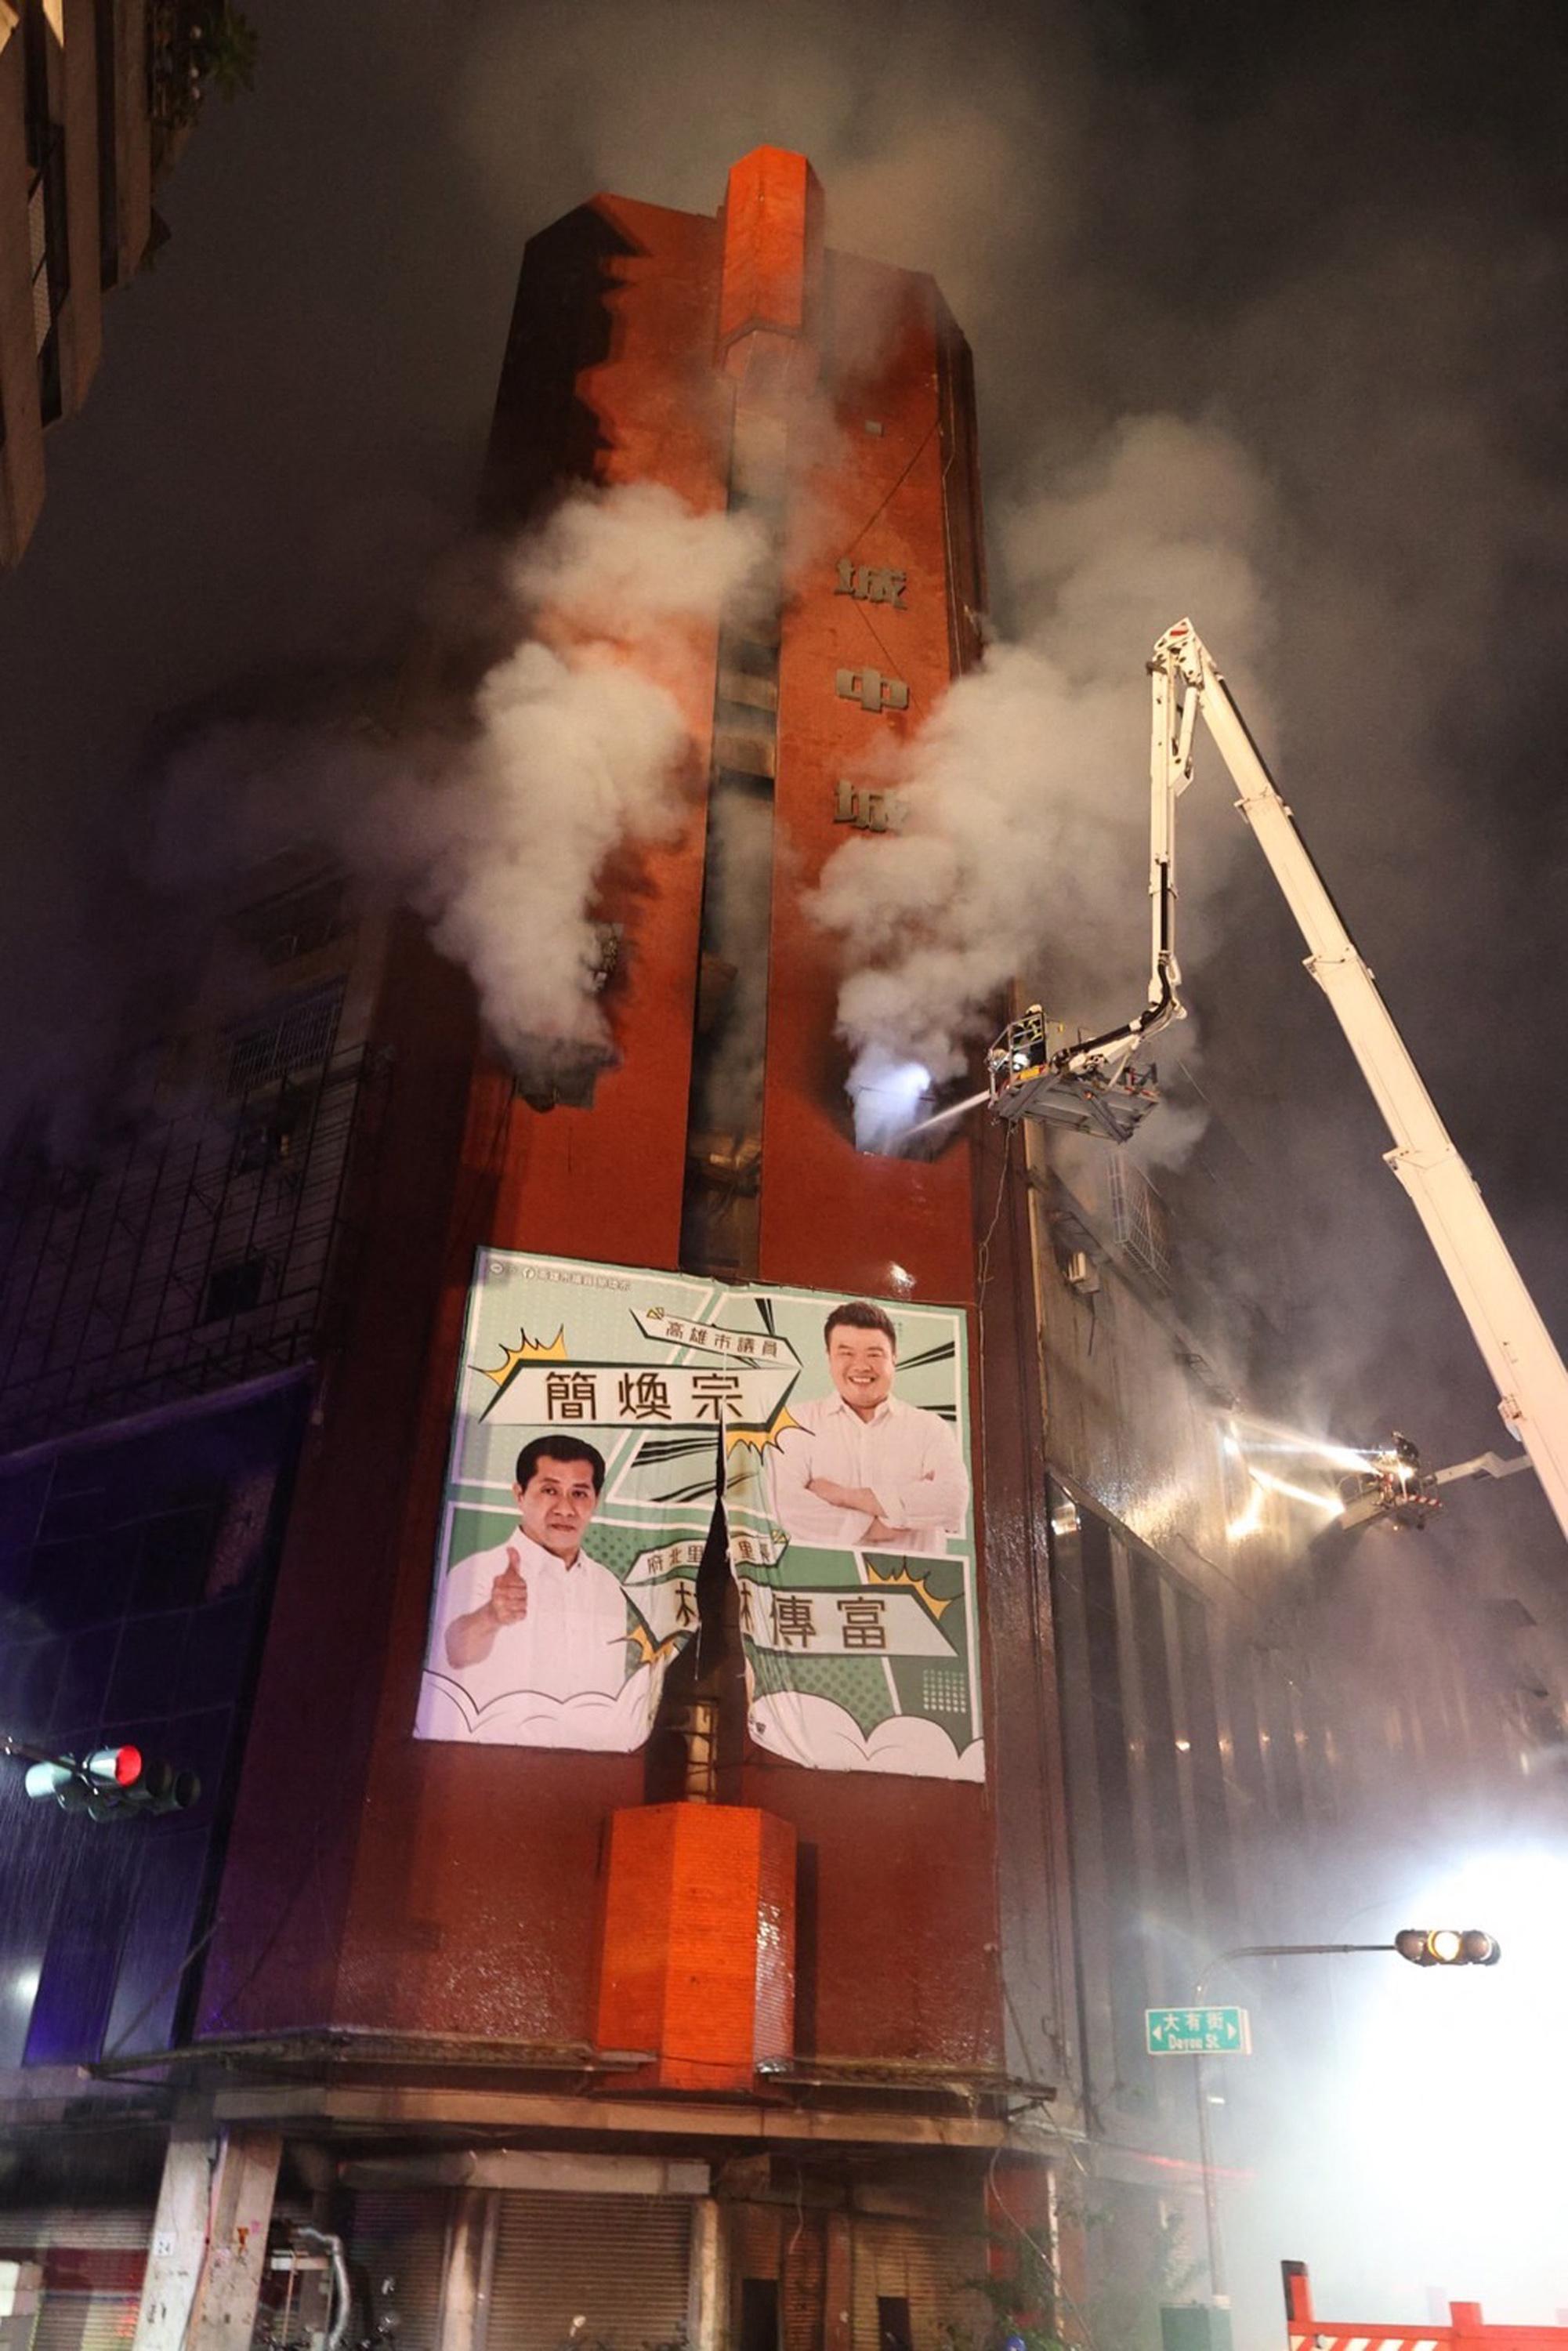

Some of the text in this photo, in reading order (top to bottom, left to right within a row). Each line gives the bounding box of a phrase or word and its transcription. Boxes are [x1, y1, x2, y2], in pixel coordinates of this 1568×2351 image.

[665, 1321, 778, 1357] 高雄市議員
[545, 1371, 744, 1421] 簡煥宗
[1163, 2012, 1224, 2032] 大有街
